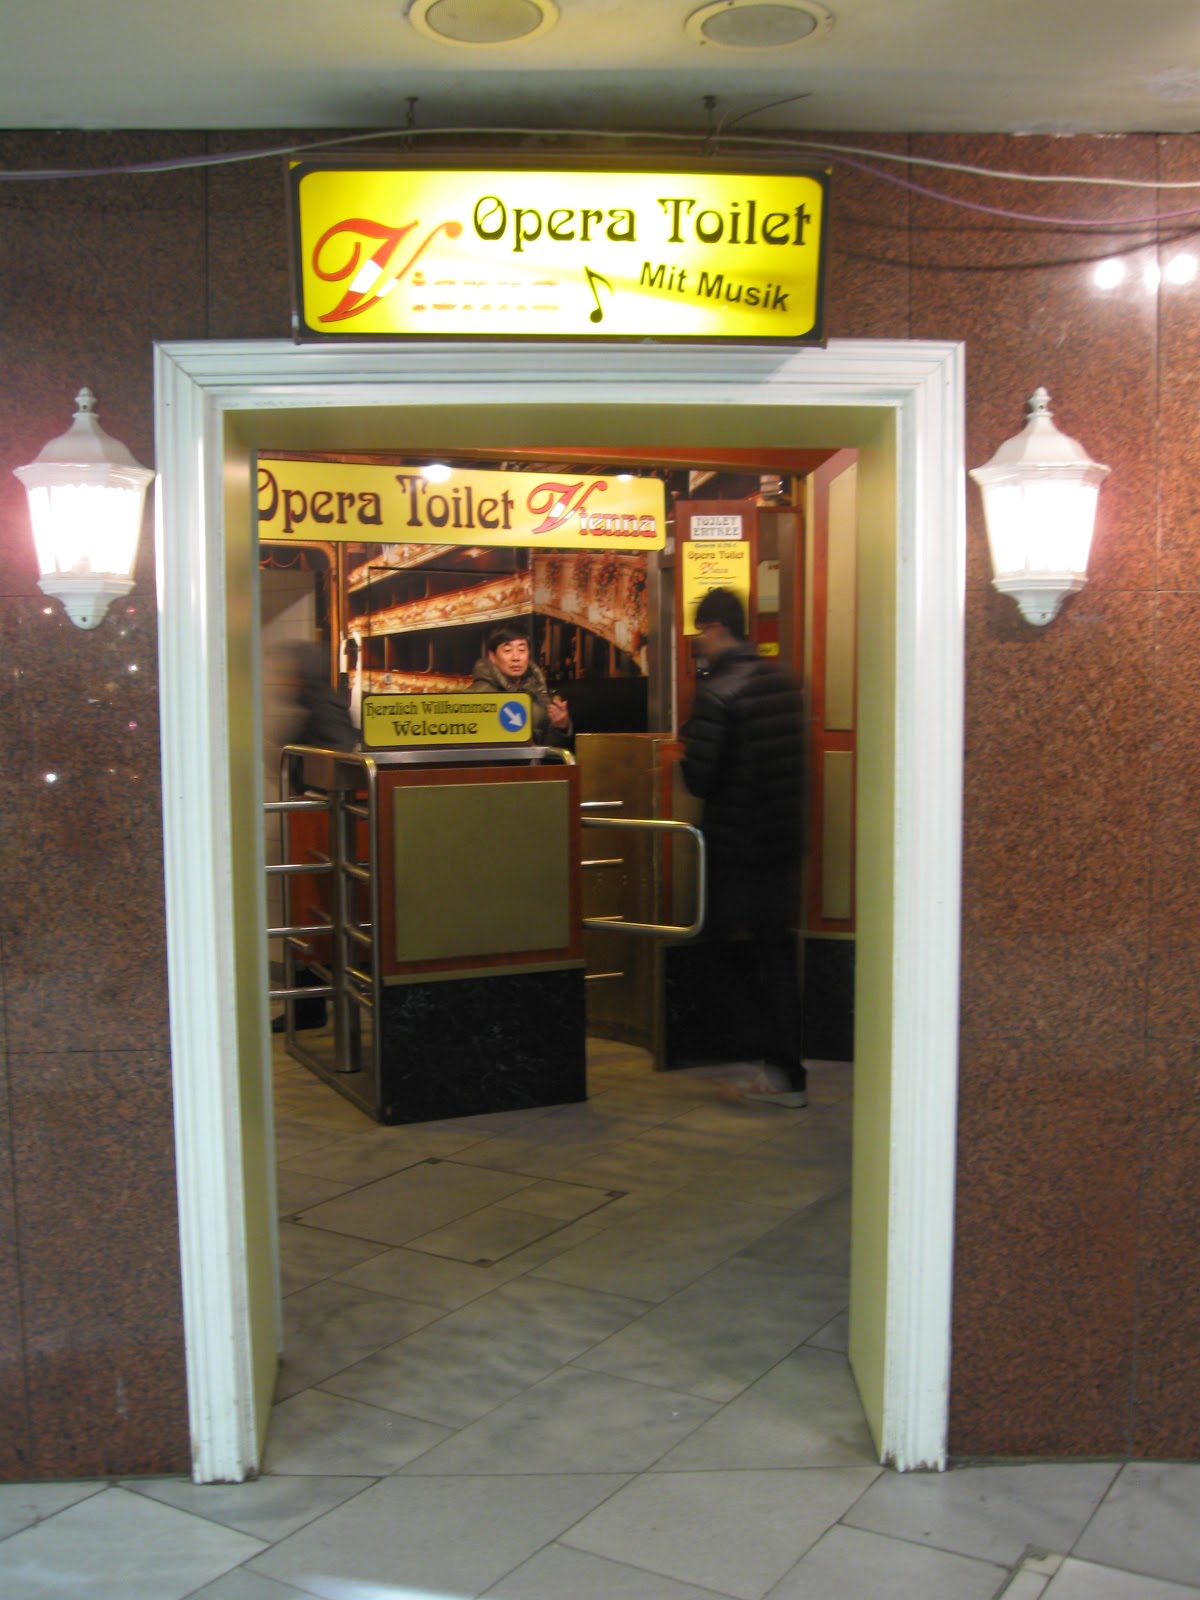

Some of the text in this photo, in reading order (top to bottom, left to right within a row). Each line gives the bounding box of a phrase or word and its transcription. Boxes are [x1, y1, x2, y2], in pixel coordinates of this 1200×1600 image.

[473, 196, 812, 252] Opera Toilet
[640, 261, 790, 312] Mit Musik
[257, 469, 658, 538] Opera Toilet Vienna
[695, 516, 738, 526] TOILET
[421, 700, 498, 715] Willkommen
[392, 720, 479, 736] Welcome
